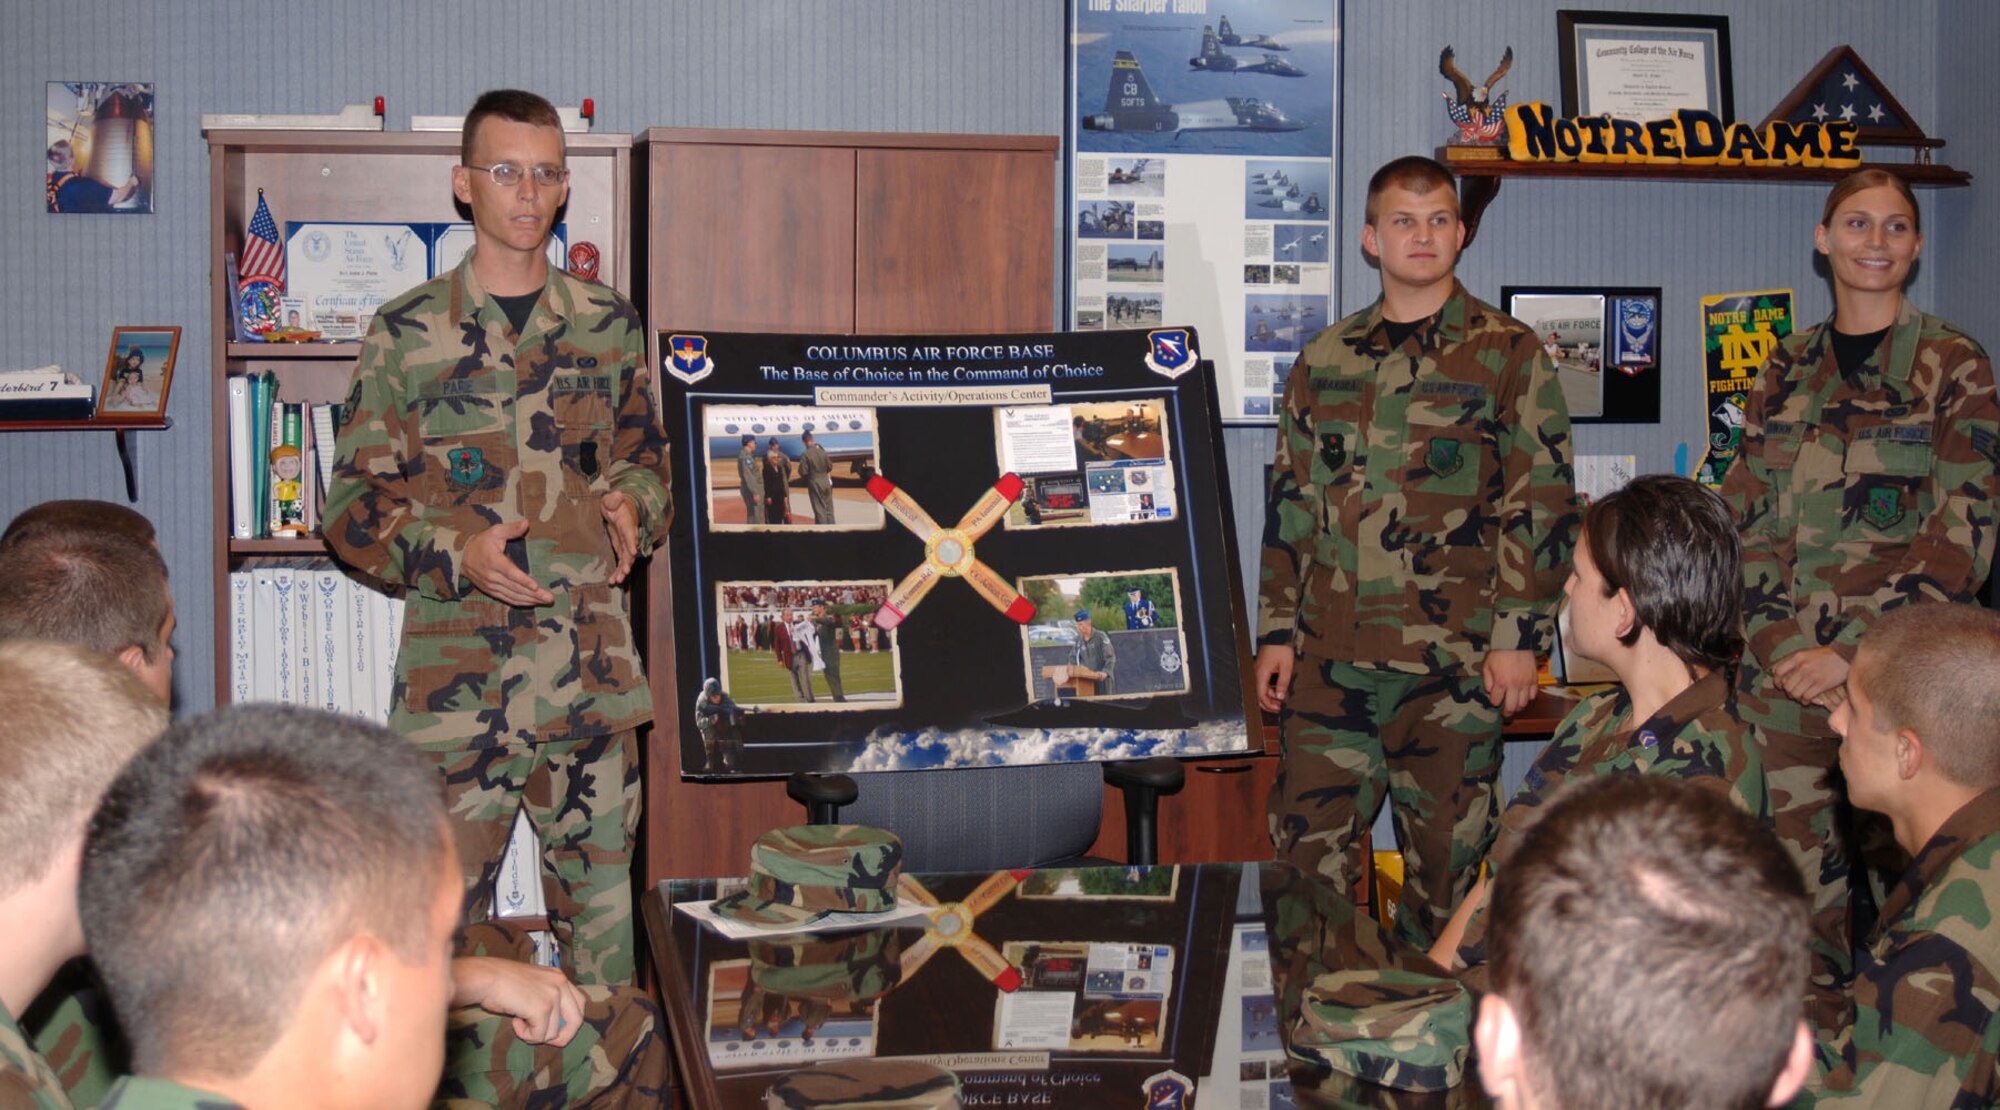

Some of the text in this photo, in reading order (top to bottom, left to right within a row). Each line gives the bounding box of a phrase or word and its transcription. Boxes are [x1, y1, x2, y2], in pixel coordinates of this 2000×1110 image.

[1088, 0, 1207, 14] The Sharper Talon
[1629, 44, 1650, 55] College
[1123, 83, 1138, 95] CB
[1709, 307, 1785, 326] NOTRE DAME
[1558, 320, 1570, 330] AIR
[1573, 319, 1601, 329] FORCE
[807, 344, 1055, 361] COLUMBUS AIR FORCE BASE
[759, 362, 1104, 381] The Base of Choice in the Command of Choice
[50, 381, 59, 391] 7
[576, 377, 590, 389] AIR
[820, 387, 1048, 404] Commander's Activity/Operations Center
[821, 413, 865, 421] AMERICA
[1876, 426, 1891, 439] AIR
